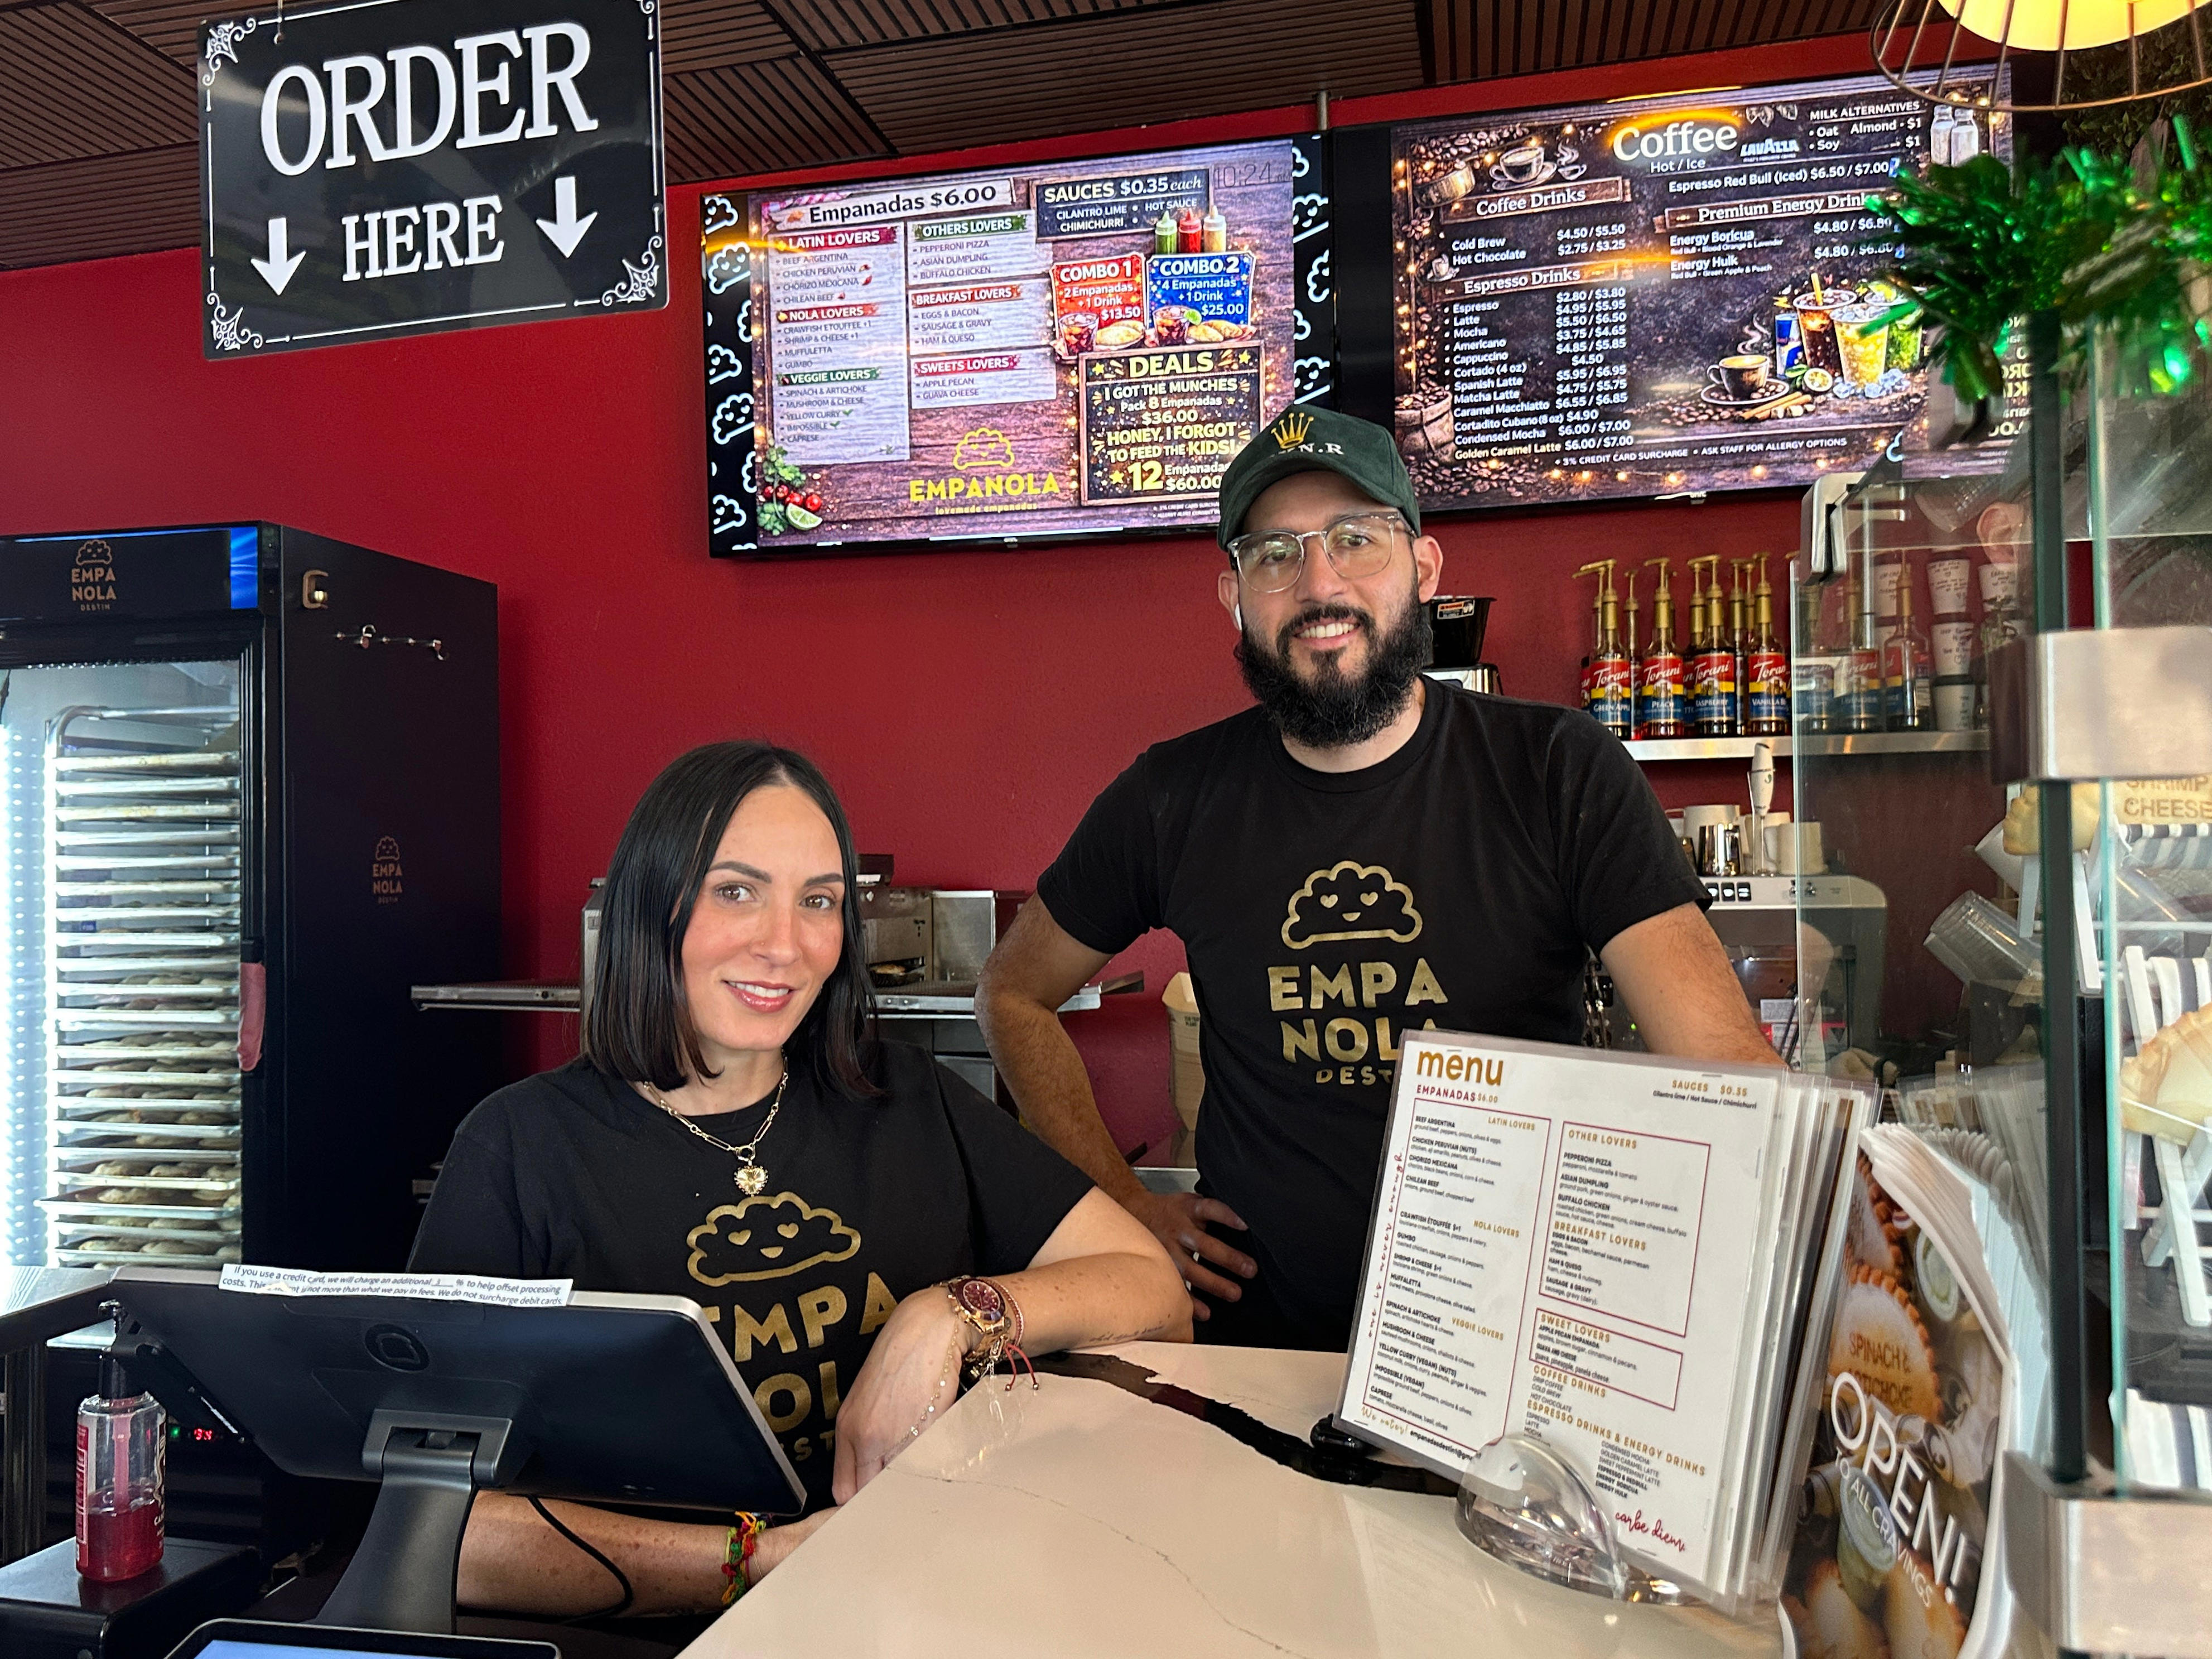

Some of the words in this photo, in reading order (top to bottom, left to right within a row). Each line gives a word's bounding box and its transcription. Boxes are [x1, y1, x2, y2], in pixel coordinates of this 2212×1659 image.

[261, 22, 598, 177] ORDER
[1810, 109, 1838, 120] MILK
[1840, 101, 1920, 117] ALTERNATIVES
[1613, 122, 1738, 161] Coffee
[1740, 139, 1799, 157] LAVAZZA
[1650, 160, 1675, 172] Hot
[1686, 158, 1705, 169] Ice
[1669, 180, 1722, 194] Espresso
[1724, 175, 1746, 187] Red
[1749, 172, 1771, 185] Bull
[1774, 168, 1808, 185] (Iced)
[1811, 166, 1845, 180] $6.50
[1854, 162, 1889, 176] $7.00
[1044, 182, 1115, 203] SAUCES
[1120, 177, 1168, 197] $0.35
[1170, 178, 1202, 191] each
[810, 194, 924, 223] Empanadas
[931, 186, 996, 207] $6.00
[1145, 202, 1164, 211] HOT
[1167, 199, 1197, 209] SAUCE
[1476, 199, 1526, 216] Coffee
[1531, 187, 1586, 206] Drinks
[1699, 204, 1768, 222] Premium
[1772, 196, 1823, 216] Energy
[1057, 208, 1102, 220] CILANTRO
[1105, 205, 1127, 215] LIME
[923, 223, 967, 237] OTHERS
[971, 219, 1011, 233] LOVERS
[1060, 219, 1124, 232] CHIMICHURRI
[1557, 226, 1588, 241] $4.50
[1596, 224, 1626, 238] $5.50
[341, 194, 504, 282] HERE
[789, 235, 824, 249] LATIN
[827, 231, 880, 246] LOVERS
[920, 242, 964, 252] PEPPERONI
[966, 240, 989, 249] PIZZA
[1452, 240, 1475, 251] Cold
[1478, 236, 1506, 249] Brew
[946, 254, 988, 264] DUMPLING
[1160, 260, 1224, 276] COMBO
[1226, 257, 1239, 273] 2
[921, 269, 955, 279] BUFFALO
[957, 266, 991, 276] CHICKEN
[1061, 264, 1120, 282] COMBO
[1122, 262, 1131, 277] 1
[1064, 289, 1071, 298] 2
[1072, 283, 1133, 297] Empanadas
[1162, 280, 1170, 290] 4
[1172, 278, 1236, 291] Empanadas
[1464, 276, 1528, 295] Espresso
[1531, 268, 1580, 285] Drinks
[917, 291, 971, 305] BREAKFAST
[974, 287, 1011, 300] LOVERS
[1086, 298, 1091, 308] 1
[1094, 295, 1122, 307] Drink
[1186, 291, 1192, 302] 1
[1194, 290, 1223, 302] Drink
[789, 310, 818, 321] NOLA
[821, 307, 864, 319] LOVERS
[921, 311, 942, 319] EGGS
[951, 308, 979, 317] BACON
[1101, 308, 1141, 321] $13.50
[1202, 303, 1244, 317] $25.00
[1453, 301, 1499, 314] Espresso
[1453, 316, 1480, 326] Latte
[921, 361, 964, 373] SWEETS
[967, 358, 1009, 370] LOVERS
[1130, 351, 1214, 378] DEALS
[791, 372, 827, 383] VEGGIE
[830, 369, 870, 381] LOVERS
[923, 379, 946, 388] APPLE
[948, 377, 974, 386] PECAN
[1105, 388, 1110, 401] I
[1112, 385, 1140, 399] GOT
[1142, 383, 1165, 396] THE
[1169, 378, 1237, 394] MUNCHES
[1121, 399, 1146, 413] Pack
[1149, 398, 1158, 409] 8
[1161, 397, 1222, 409] Empanadas
[1142, 409, 1198, 426] $36.00
[1107, 427, 1163, 446] HONEY,
[1167, 426, 1172, 440] I
[1174, 421, 1237, 440] FORGOT
[1108, 448, 1127, 463] TO
[1130, 446, 1162, 461] FEED
[1164, 445, 1185, 456] THE
[1188, 439, 1235, 457] KIDS!
[1455, 448, 1488, 460] Golden
[1491, 445, 1531, 457] Caramel
[1534, 442, 1561, 453] Latte
[1720, 445, 1743, 455] STAFF
[1746, 443, 1763, 452] FOR
[1766, 440, 1804, 451] ALLERGY
[1806, 437, 1847, 449] OPTIONS
[1579, 454, 1610, 464] CREDIT
[1613, 452, 1637, 462] CARD
[1638, 448, 1688, 460] SURCHARGE
[1128, 460, 1163, 491] 12
[1166, 475, 1222, 492] $60.00
[909, 472, 1059, 502] EMPANOLA
[984, 503, 1037, 514] empanadas
[71, 567, 115, 583] EMPA
[72, 585, 117, 601] NOLA
[1593, 667, 1629, 688] Torani
[1644, 663, 1680, 687] Torani
[1693, 660, 1729, 684] Torani
[2124, 798, 2212, 819] CHEESE
[373, 864, 402, 877] EMPA
[373, 880, 402, 894] NOLA
[1268, 958, 1448, 1011] EMPA
[1280, 1017, 1437, 1063] NOL
[1416, 1051, 1503, 1087] menu
[1416, 1084, 1475, 1102] EMPANADAS
[1477, 1093, 1498, 1103] $6.00
[1672, 1079, 1708, 1092] SAUCES
[1720, 1085, 1747, 1097] $0.35
[1568, 1130, 1598, 1142] OTHER
[1601, 1135, 1637, 1149] LOVERS
[1554, 1221, 1606, 1241] BREAKFAST
[1609, 1234, 1646, 1251] LOVERS
[242, 1268, 257, 1276] you
[283, 1272, 305, 1282] credit
[354, 1276, 379, 1285] charge
[477, 1280, 495, 1291] help
[497, 1282, 518, 1291] offset
[520, 1284, 561, 1295] processing
[702, 1271, 898, 1362] MPA
[1849, 1332, 1900, 1369] SPINACH
[1534, 1365, 1568, 1384] COFFEE
[1571, 1377, 1606, 1398] DRINKS
[1831, 1372, 1967, 1604] OPEN!
[1835, 1446, 1850, 1479] TO
[1850, 1477, 1871, 1513] ALL
[1872, 1507, 1933, 1608] CRAVINGS
